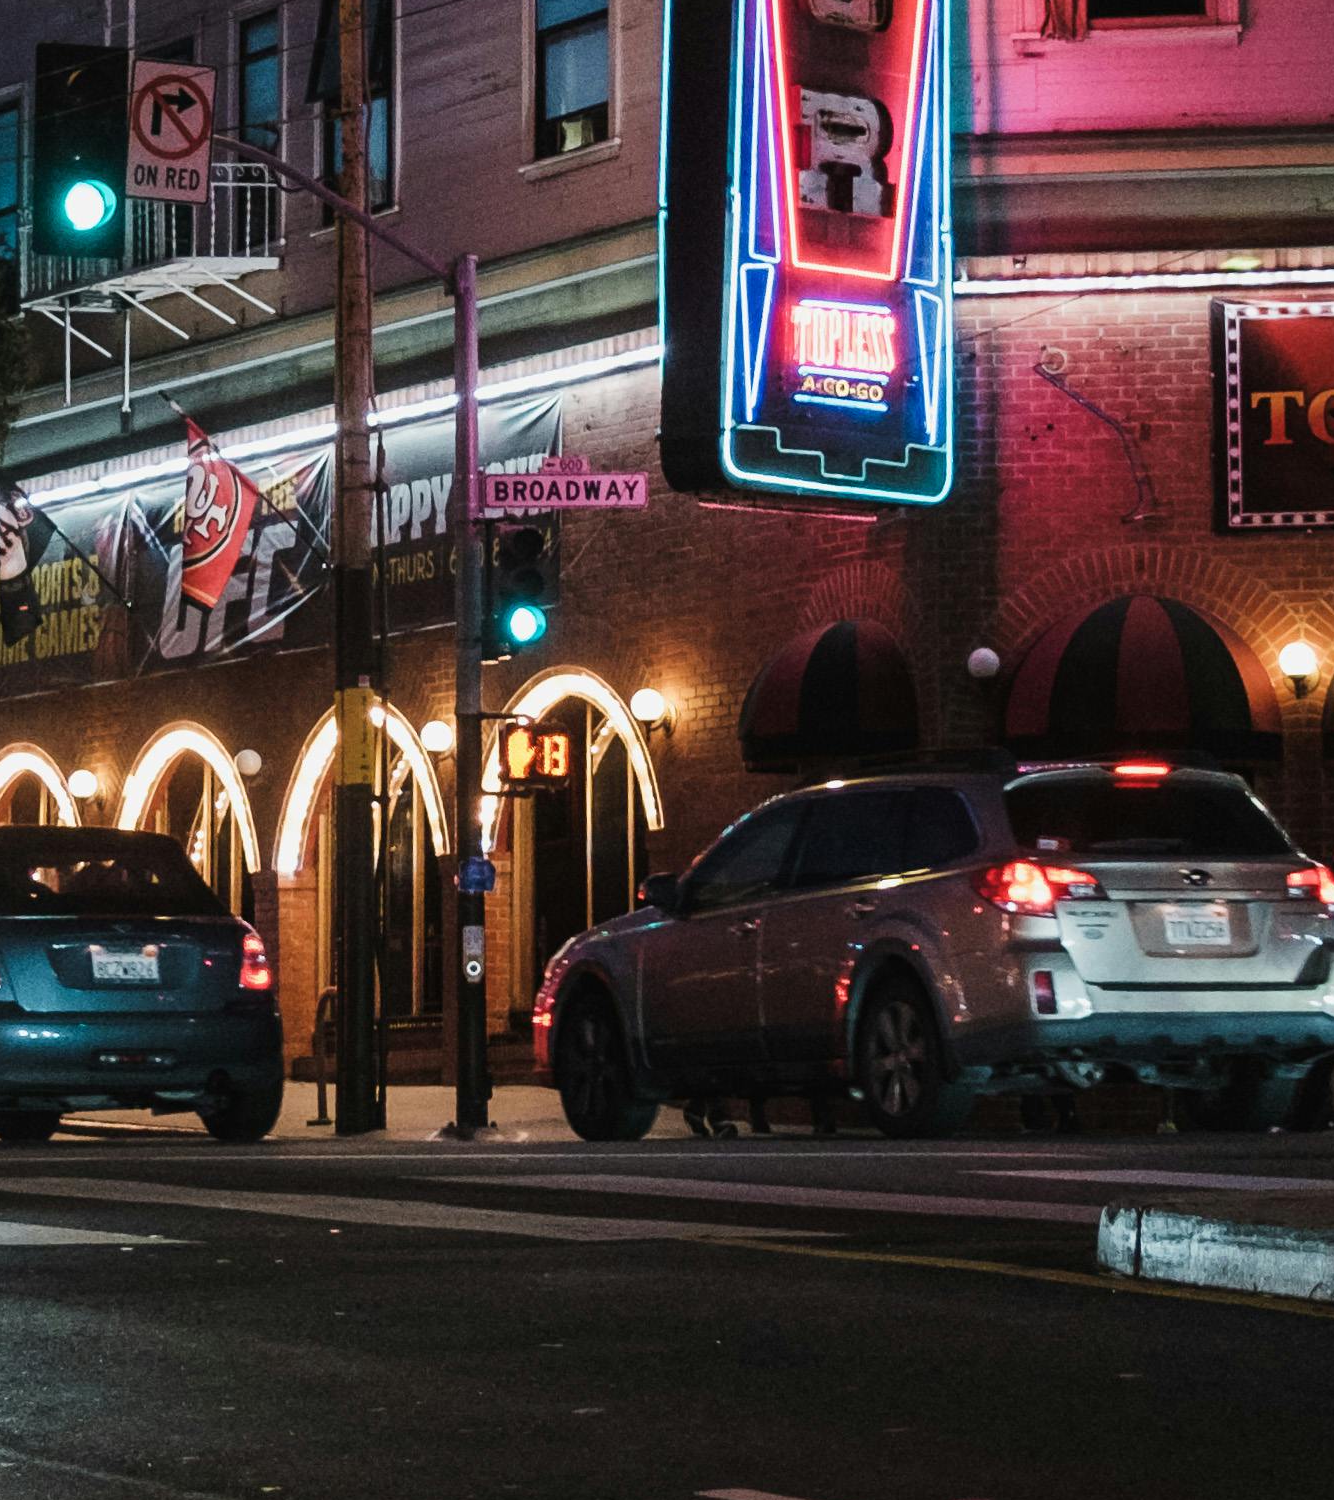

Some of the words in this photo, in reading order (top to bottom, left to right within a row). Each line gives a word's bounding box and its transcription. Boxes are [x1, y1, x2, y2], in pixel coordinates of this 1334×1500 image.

[134, 164, 158, 186] ON
[166, 167, 200, 190] RED
[791, 306, 895, 374] TOPLESS
[370, 473, 453, 548] APPY
[494, 479, 639, 502] BROADWAY
[31, 556, 83, 606] PORTS
[34, 605, 103, 660] GAMES
